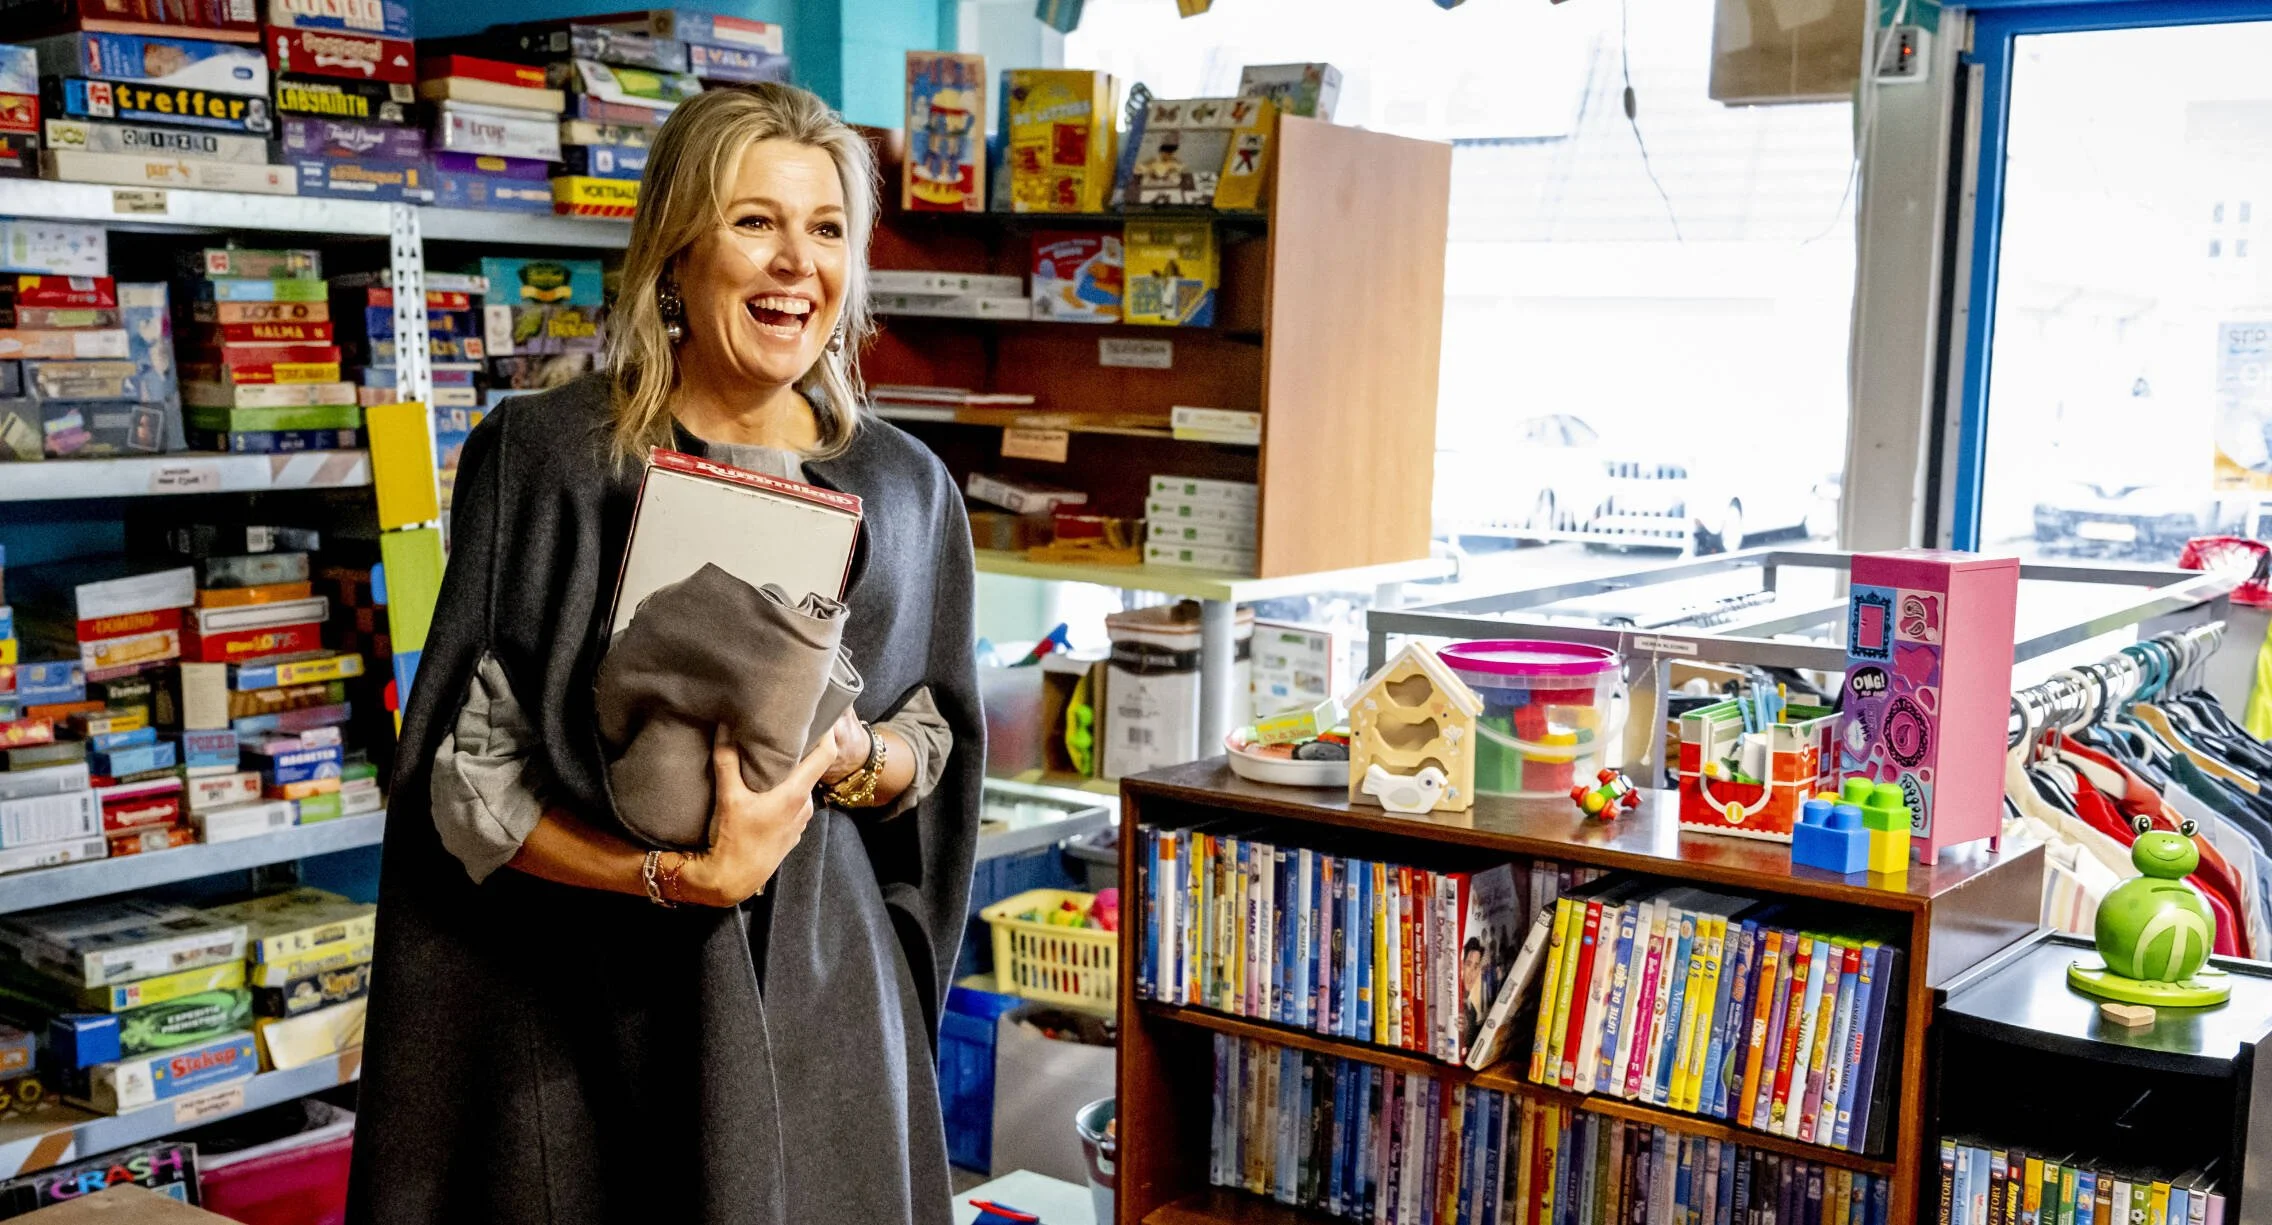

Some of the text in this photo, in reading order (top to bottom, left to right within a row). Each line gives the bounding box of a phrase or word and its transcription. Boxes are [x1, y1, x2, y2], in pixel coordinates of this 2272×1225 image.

[115, 84, 245, 119] treffer
[122, 129, 217, 153] QUIZZLE
[697, 461, 854, 505] Rummikub
[1853, 672, 1886, 690] OMG!
[50, 1150, 183, 1199] CRASH
[1940, 1175, 1952, 1206] STORY
[1990, 1185, 2000, 1217] STORY
[2006, 1181, 2020, 1219] BATMAN
